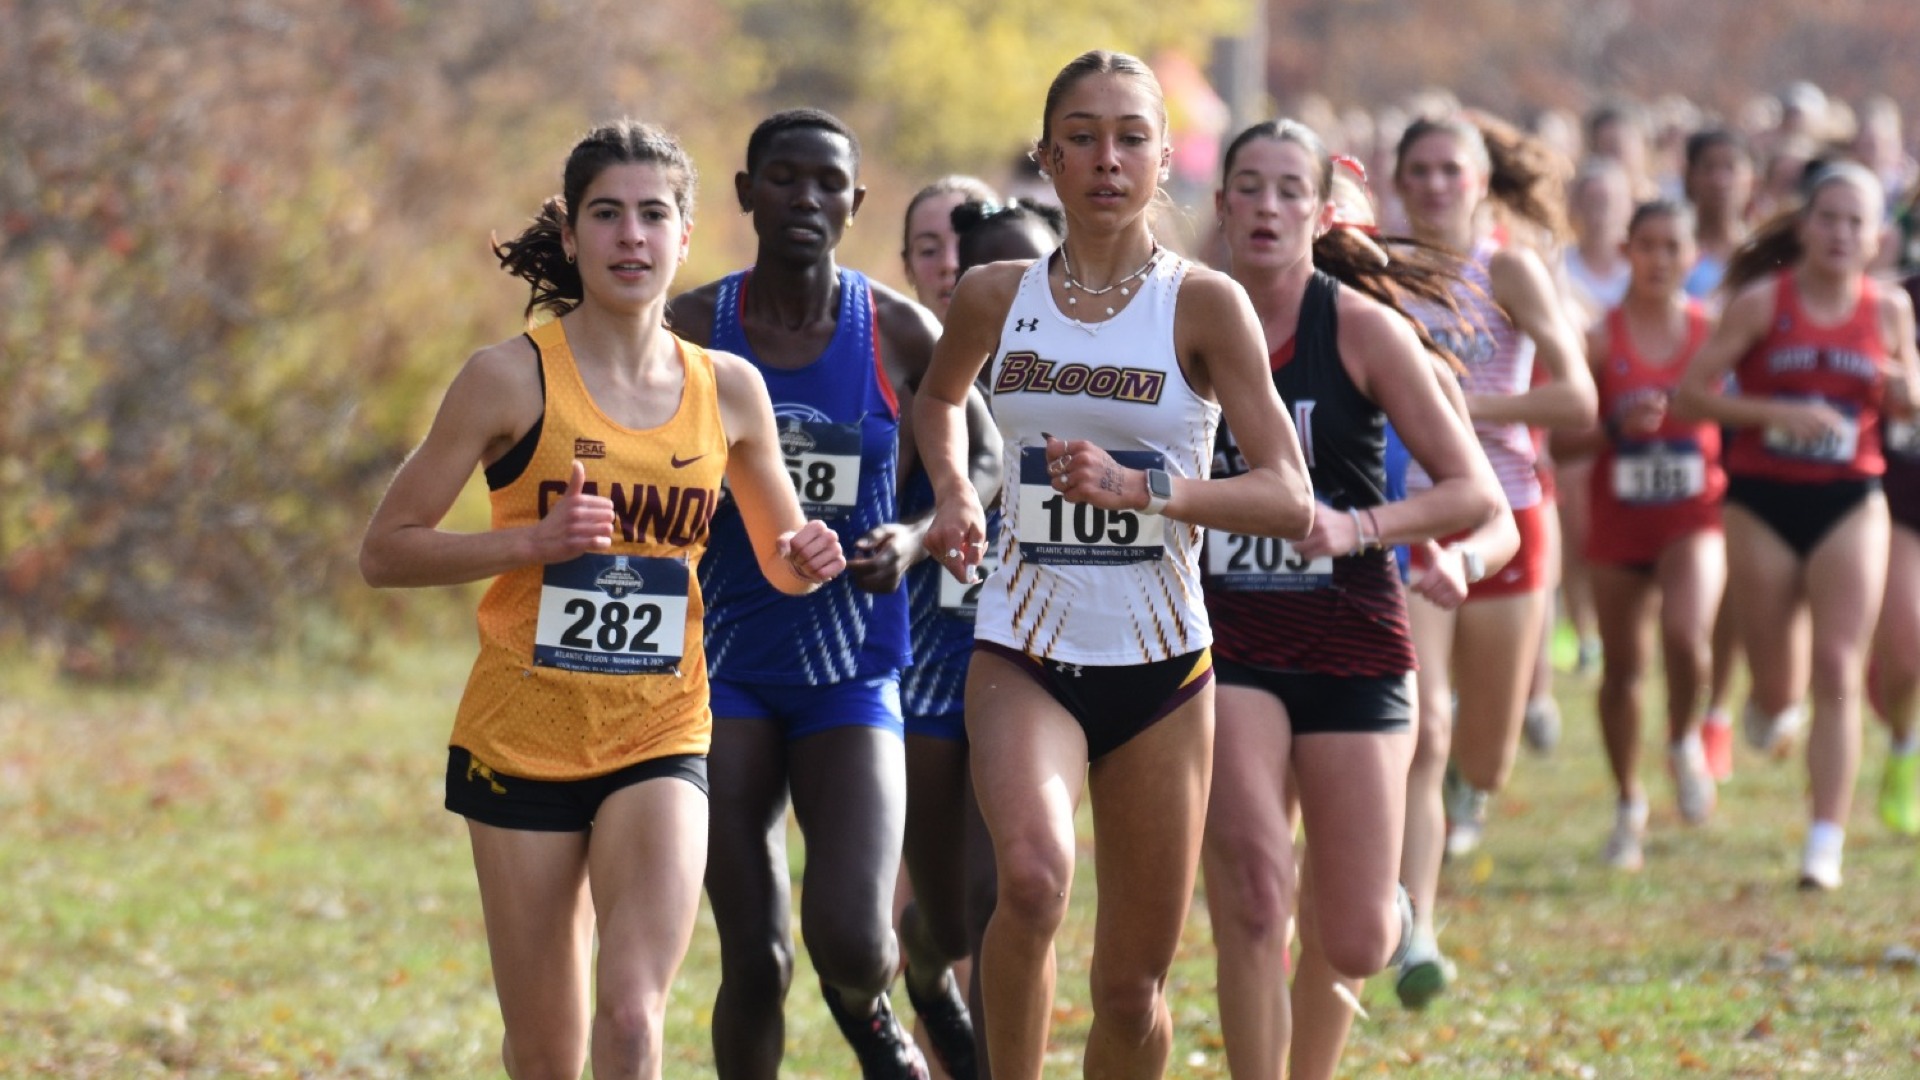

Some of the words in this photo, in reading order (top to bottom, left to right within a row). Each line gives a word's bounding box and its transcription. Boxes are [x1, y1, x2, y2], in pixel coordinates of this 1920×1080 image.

[995, 351, 1166, 405] BLOOM
[574, 444, 606, 455] PSAC
[1042, 494, 1139, 544] 105
[560, 598, 662, 653] 282
